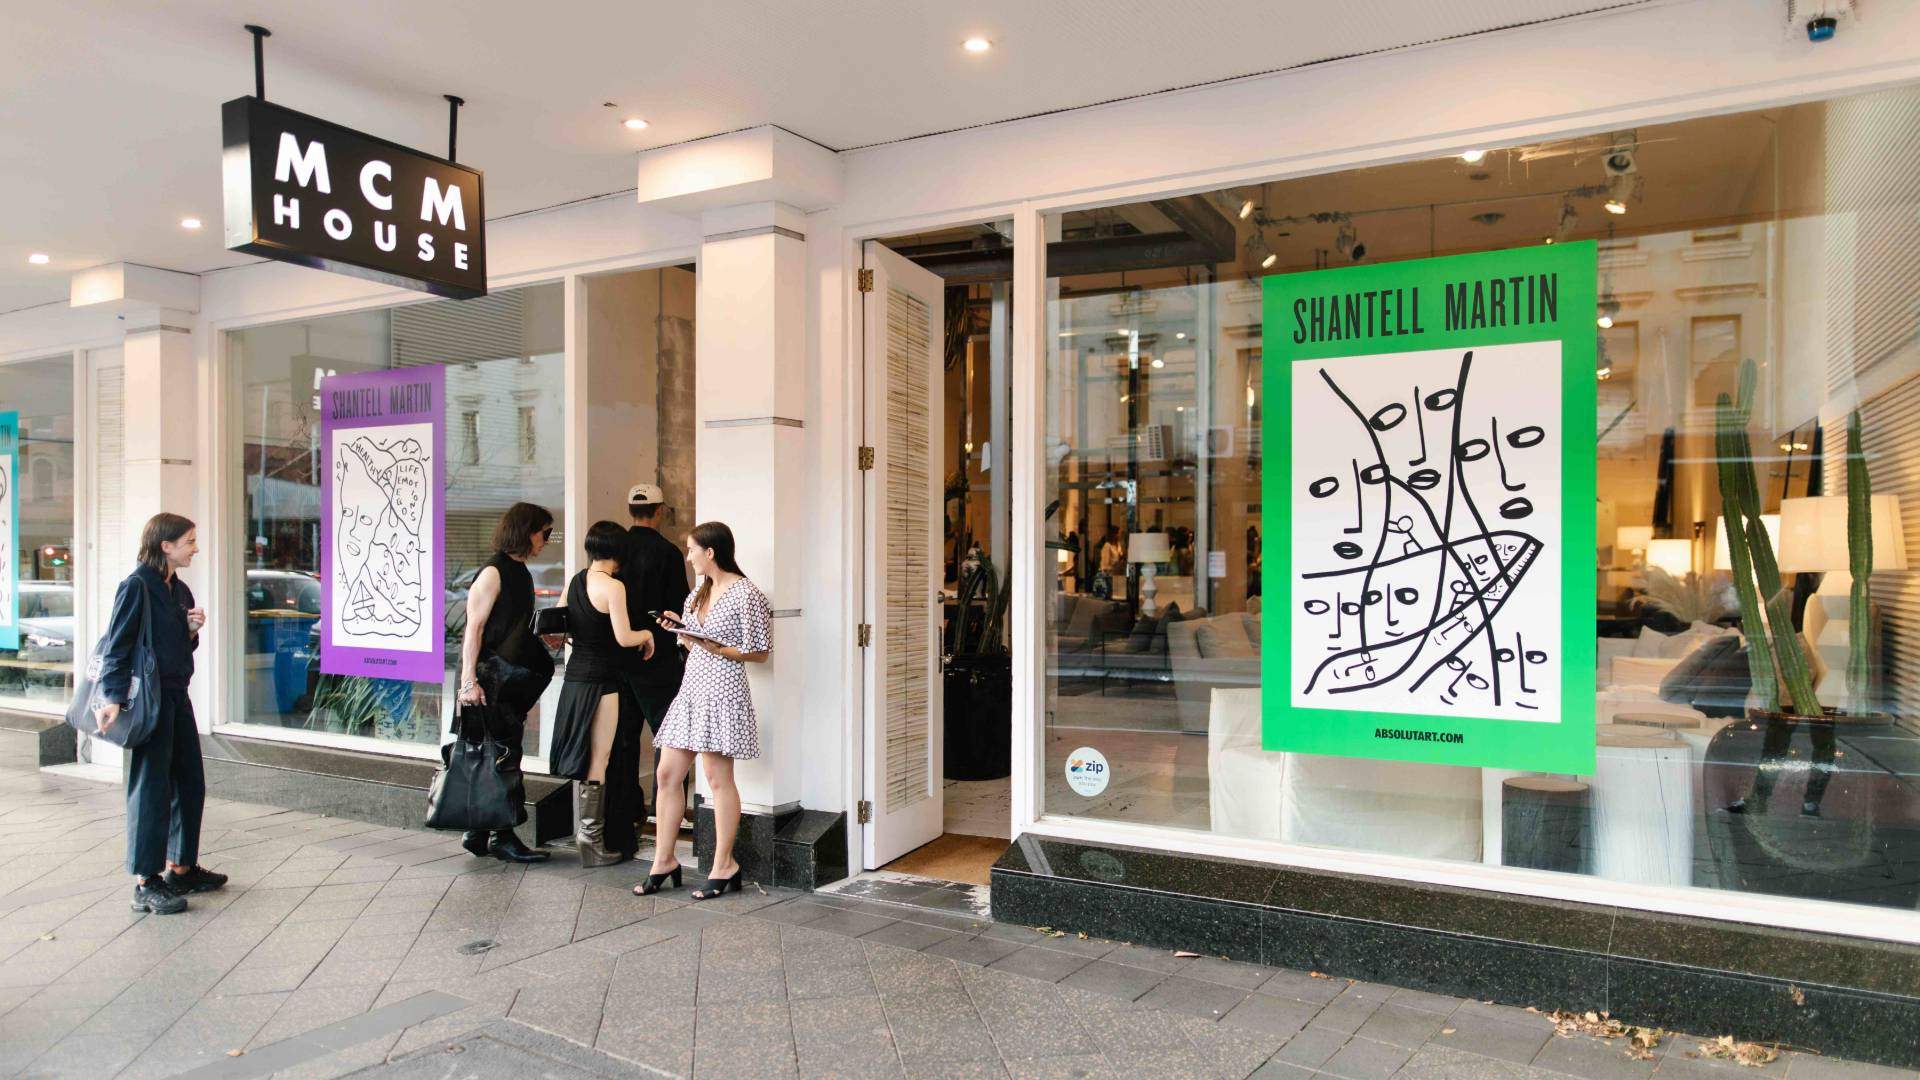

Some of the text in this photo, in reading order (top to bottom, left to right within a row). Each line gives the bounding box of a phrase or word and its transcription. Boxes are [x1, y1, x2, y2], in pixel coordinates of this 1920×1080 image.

[275, 131, 466, 231] MCM
[273, 193, 469, 270] HOUSE
[1293, 273, 1557, 344] SHANTELL MARTIN
[332, 387, 383, 420] SHANTELL
[390, 382, 432, 414] MARTIN
[355, 443, 383, 480] HEALTHY
[1375, 728, 1464, 744] ABSOLUTART.COM
[1085, 760, 1104, 774] zip
